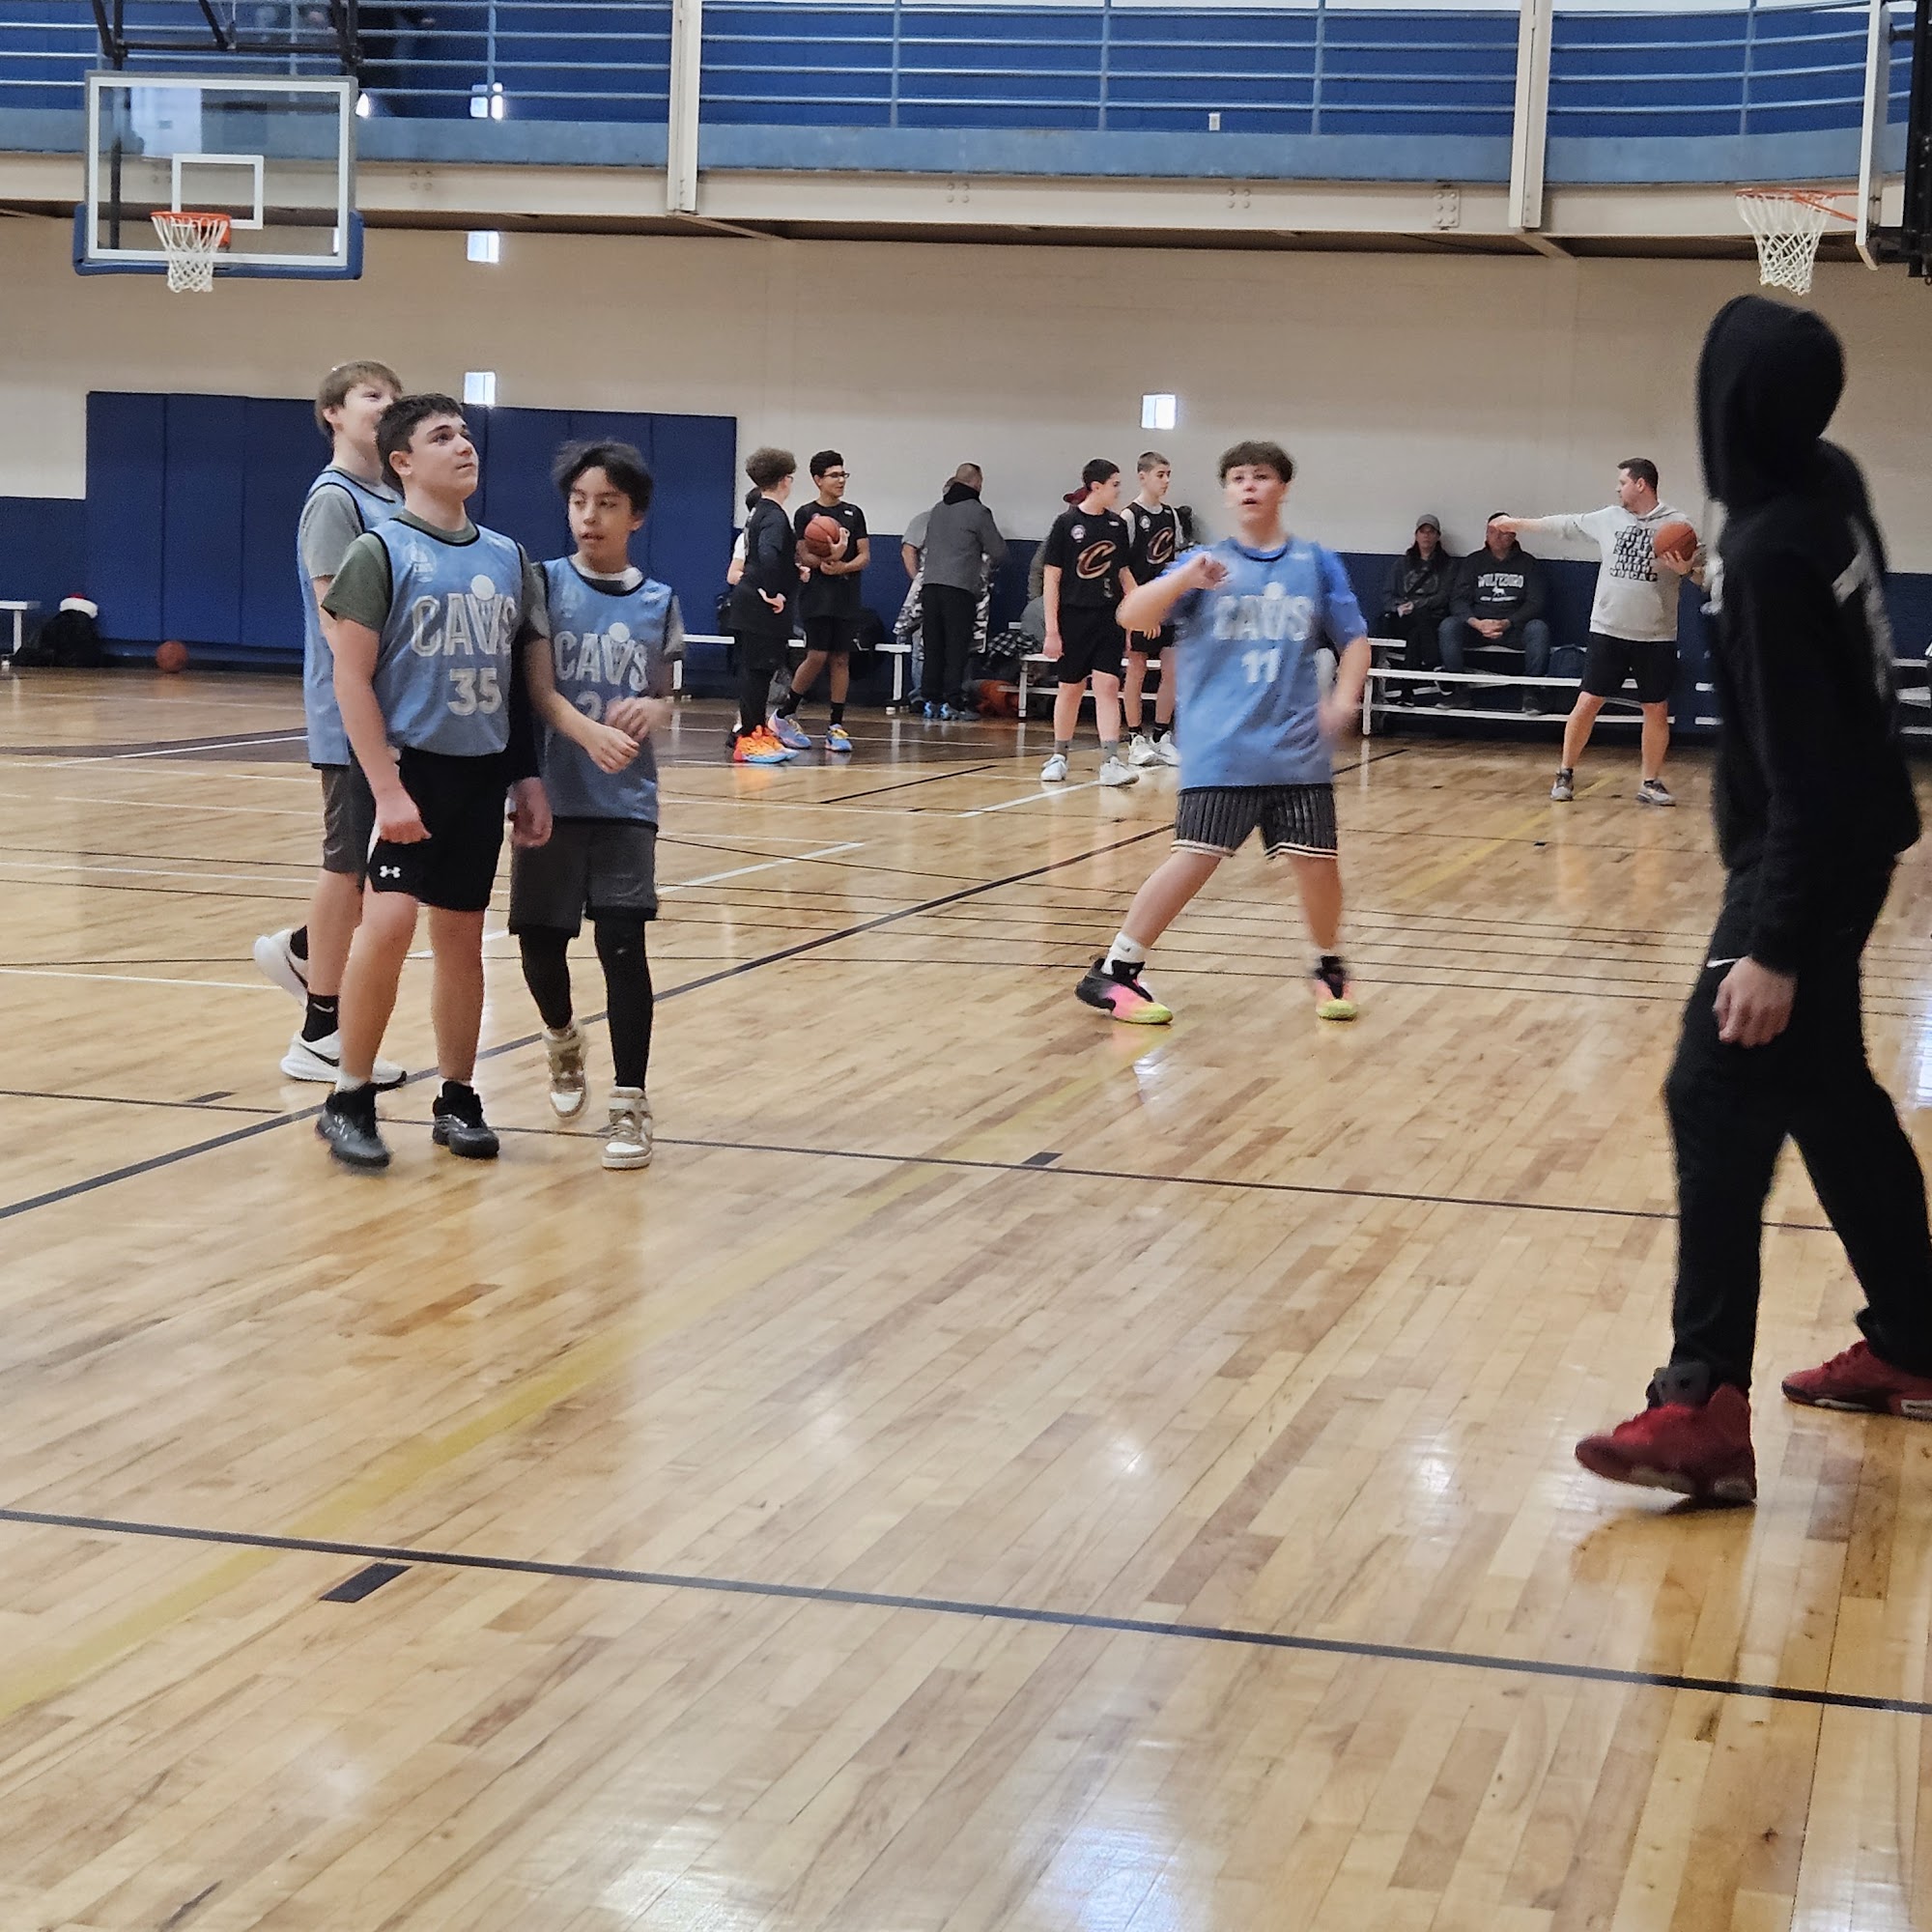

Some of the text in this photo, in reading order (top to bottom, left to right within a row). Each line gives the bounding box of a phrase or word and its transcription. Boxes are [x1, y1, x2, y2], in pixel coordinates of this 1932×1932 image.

[412, 593, 518, 658] CAVS
[1213, 595, 1314, 641] CAVS
[554, 630, 649, 692] CAVS
[447, 668, 502, 716] 35
